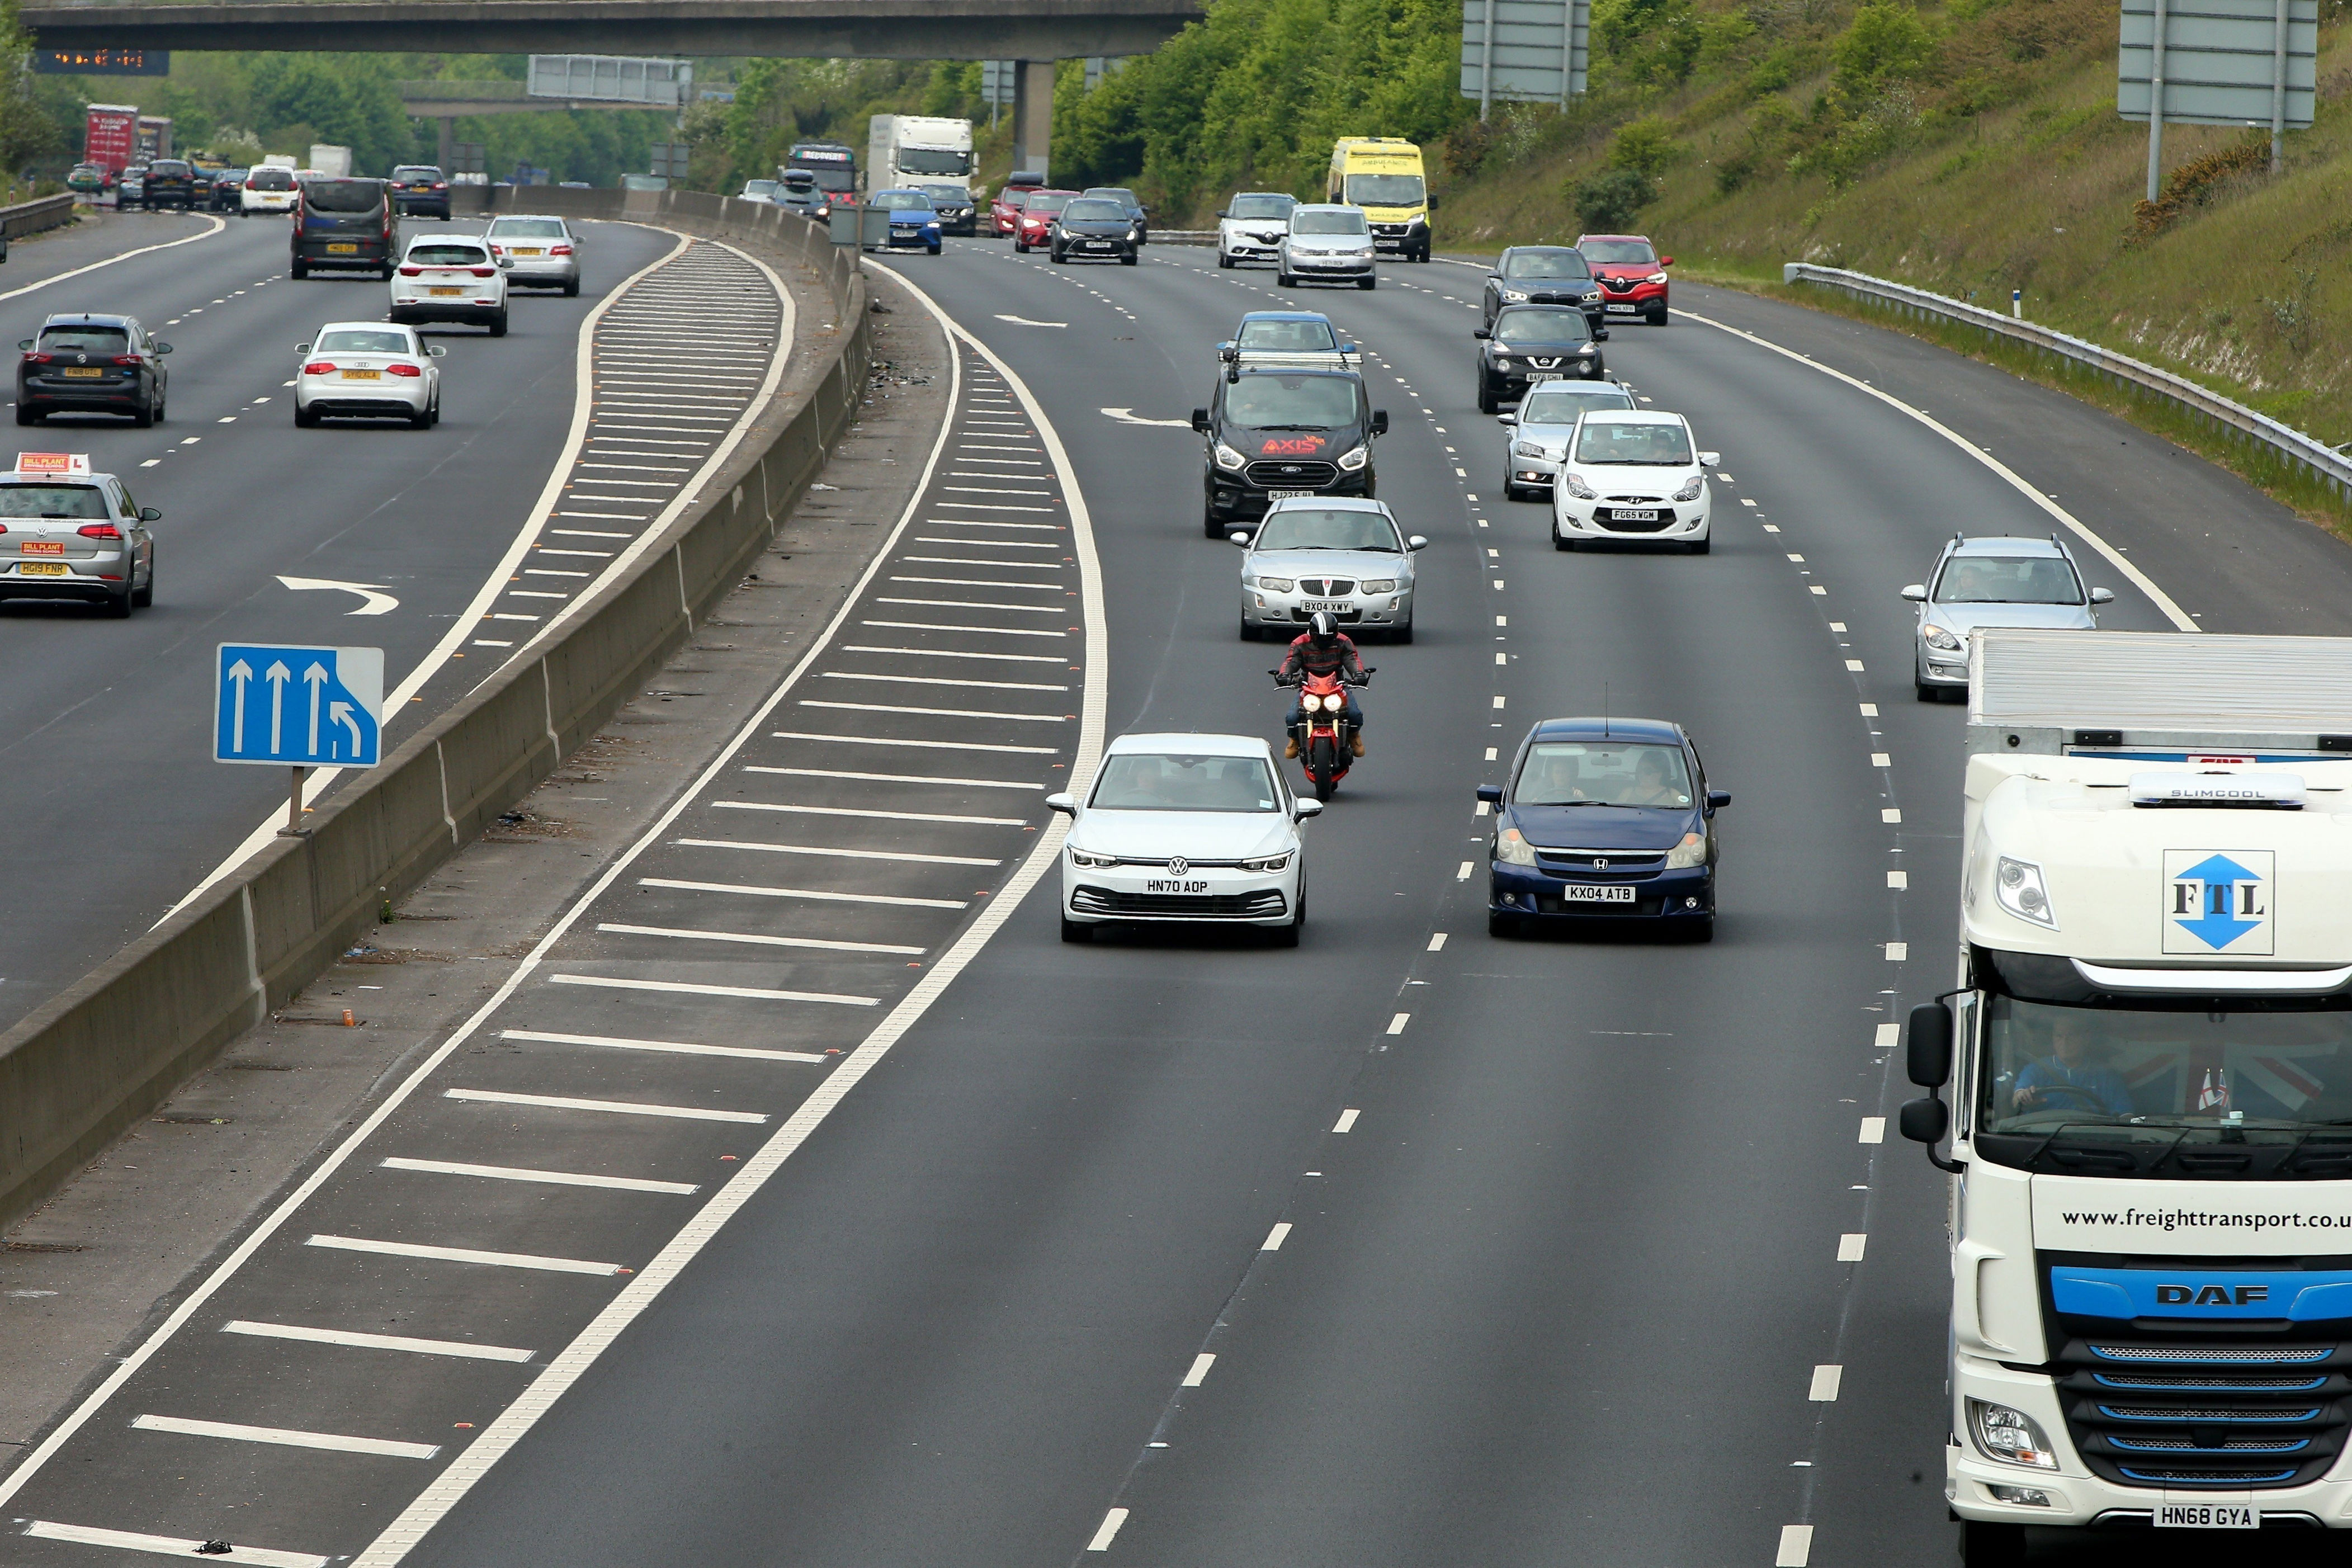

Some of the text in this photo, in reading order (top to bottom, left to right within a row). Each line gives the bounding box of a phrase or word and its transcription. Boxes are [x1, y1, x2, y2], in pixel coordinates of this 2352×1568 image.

[1263, 440, 1317, 450] AXIS
[73, 459, 82, 468] L
[23, 564, 63, 573] HG19 FNR
[1305, 602, 1349, 611] BX04 XWY
[2171, 790, 2265, 798] SLIMCOOL
[1148, 880, 1207, 892] HN70 AOP
[1571, 887, 1630, 899] KX04 ATB
[2172, 884, 2264, 915] FTL
[2157, 1284, 2269, 1305] DAF
[2162, 1507, 2251, 1525] HN68 GYA
